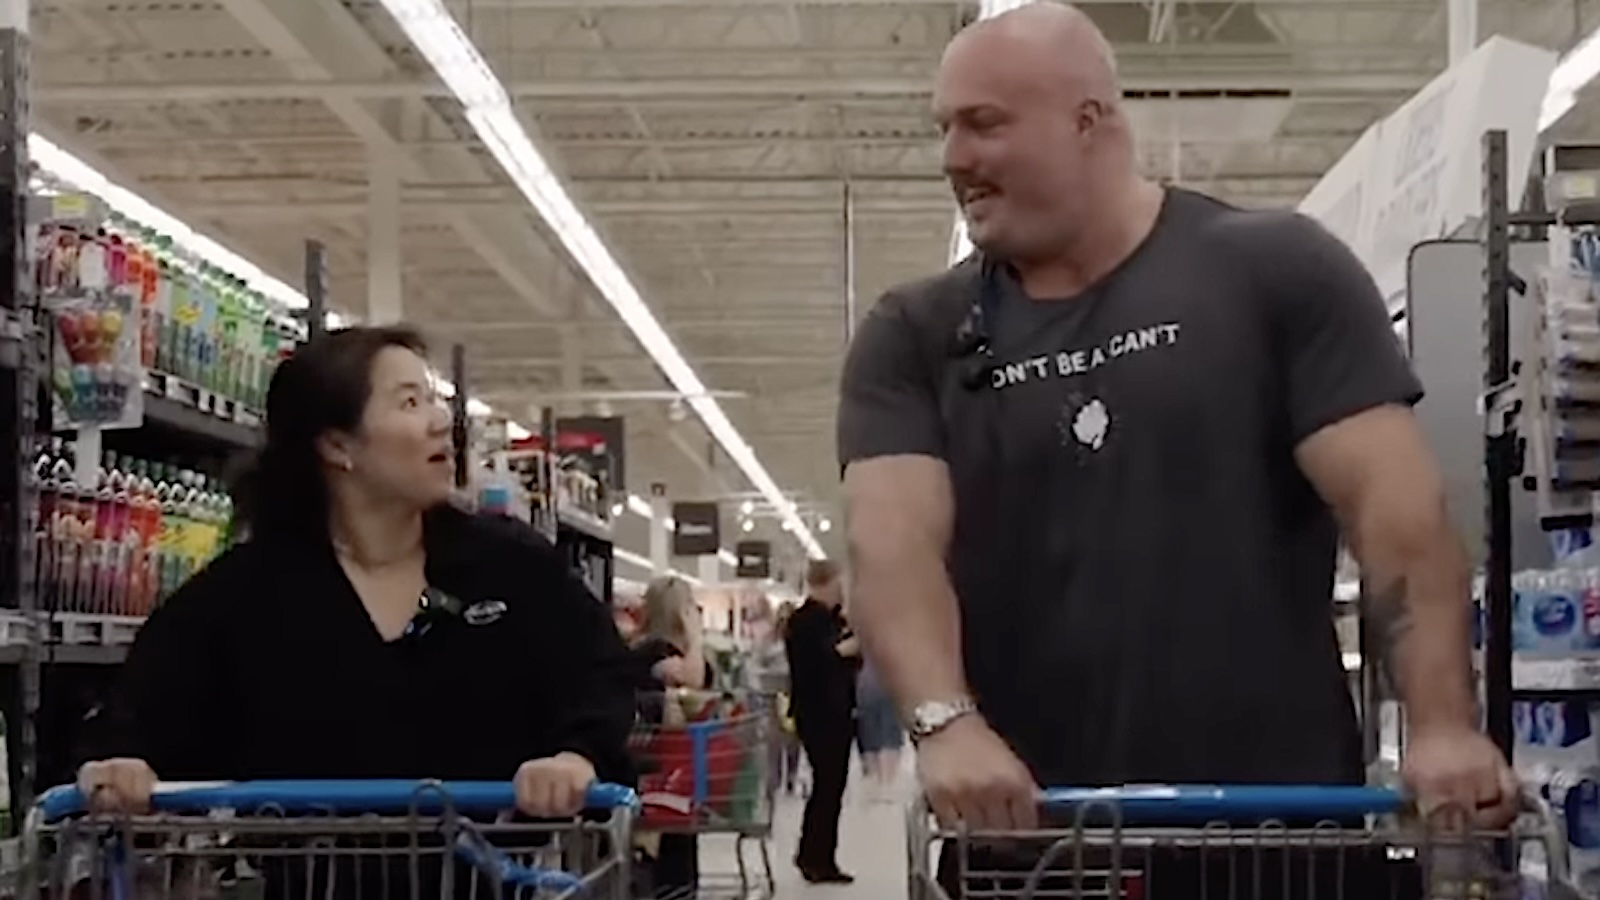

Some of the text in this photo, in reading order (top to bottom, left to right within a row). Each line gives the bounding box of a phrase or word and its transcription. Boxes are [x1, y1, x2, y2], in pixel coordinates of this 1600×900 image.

[991, 323, 1180, 388] ON'T BE A CAN'T
